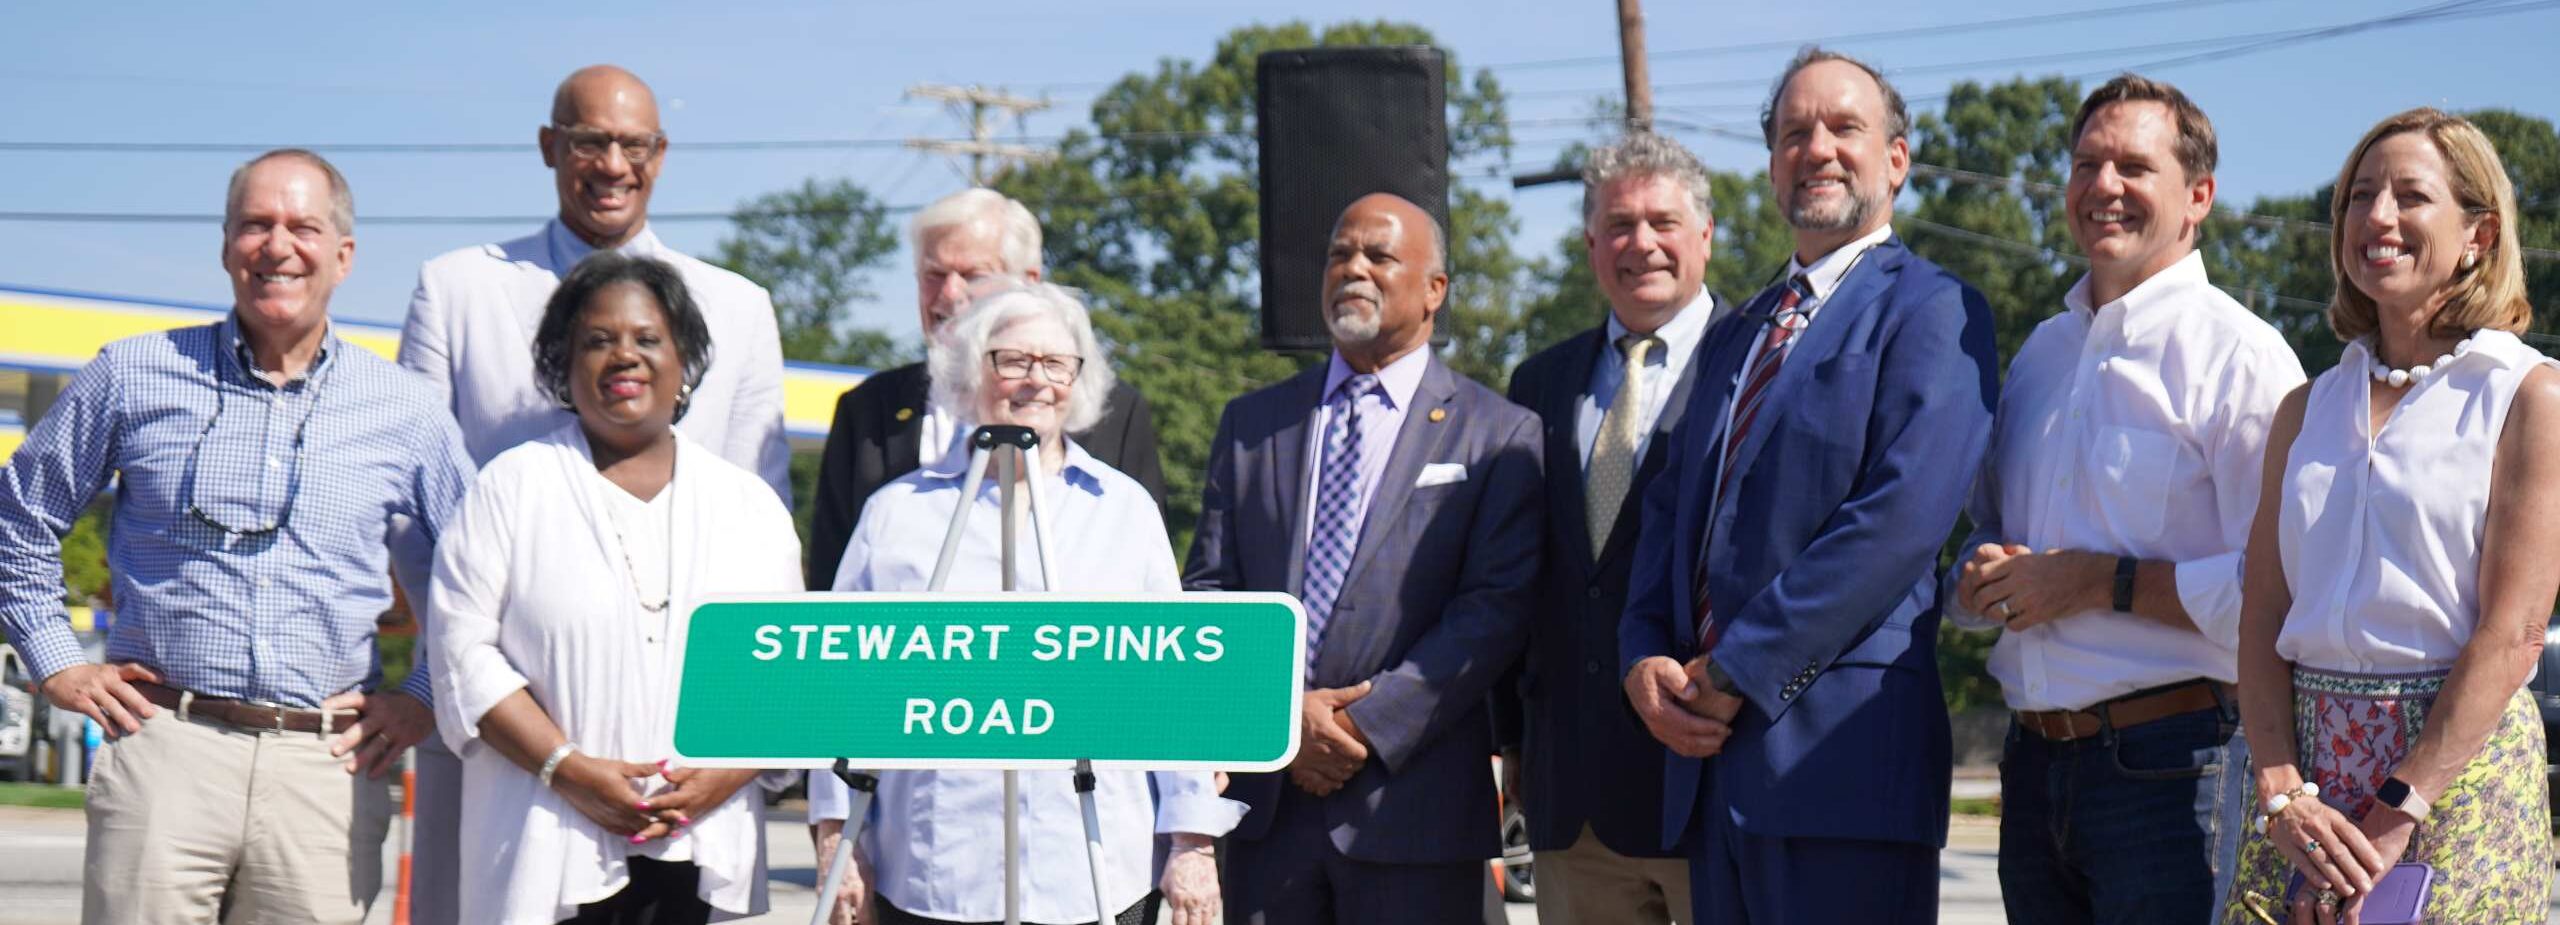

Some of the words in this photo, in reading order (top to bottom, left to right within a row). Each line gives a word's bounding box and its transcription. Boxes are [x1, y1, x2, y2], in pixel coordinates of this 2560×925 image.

[752, 624, 1010, 661] STEWART
[1032, 625, 1225, 662] SPINKS
[903, 698, 1055, 735] ROAD
